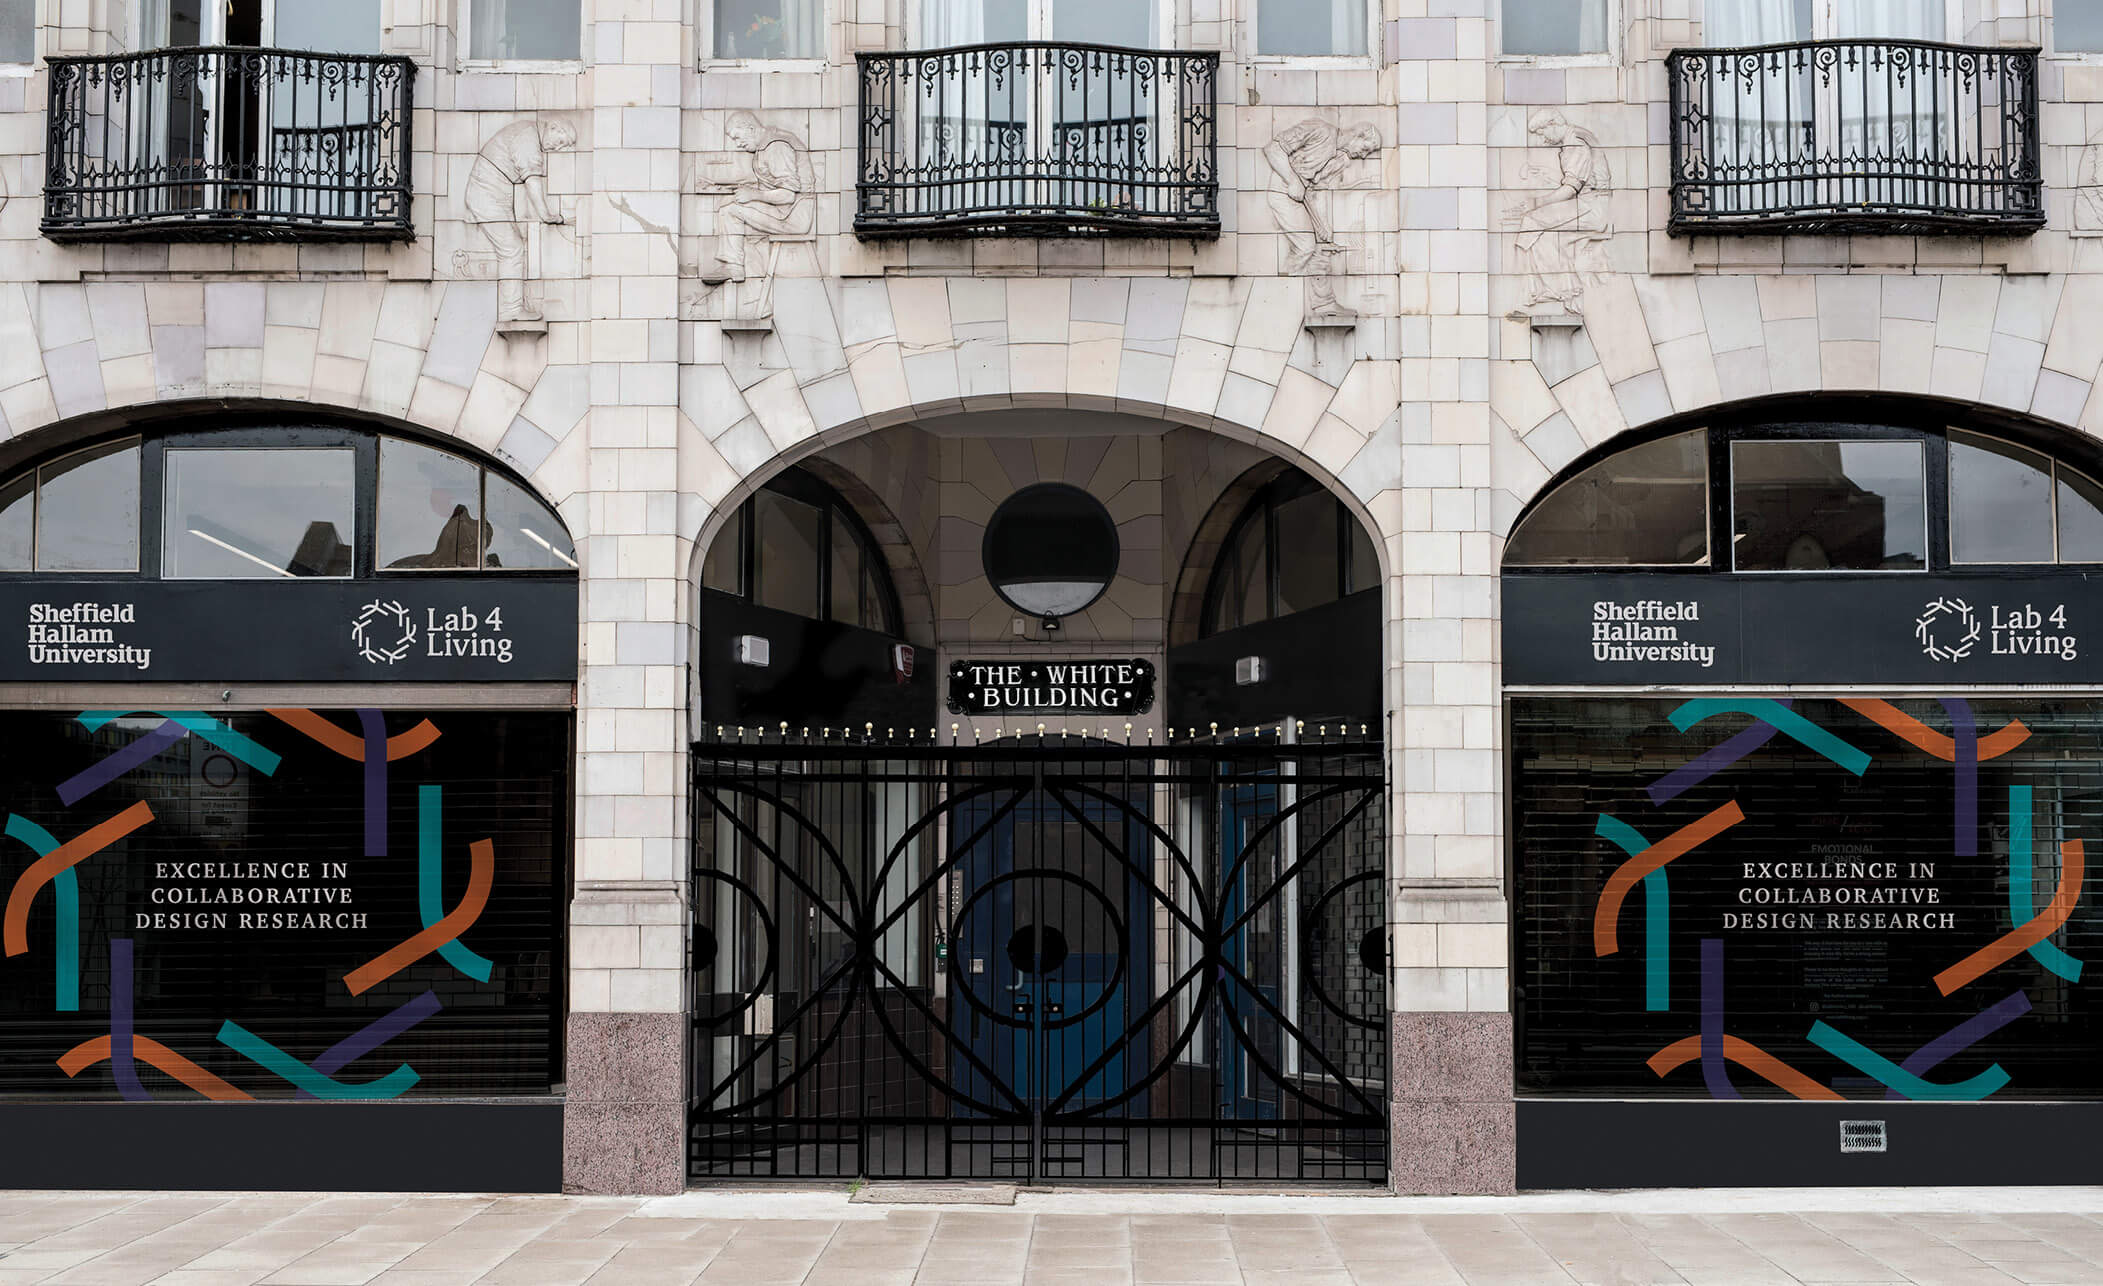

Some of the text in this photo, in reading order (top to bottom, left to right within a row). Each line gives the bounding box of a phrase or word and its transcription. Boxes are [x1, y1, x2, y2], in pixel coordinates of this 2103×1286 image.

[29, 602, 135, 624] Sheffield
[427, 605, 504, 632] Lab 4
[1593, 600, 1699, 621] Sheffield
[1991, 603, 2068, 630] Lab 4
[28, 624, 114, 643] Hallam
[1592, 621, 1678, 641] Hallam
[427, 632, 513, 663] Living
[1592, 641, 1715, 668] University
[1991, 630, 2077, 661] Living
[28, 643, 151, 670] University
[969, 664, 1134, 685] THE WHITE
[983, 687, 1118, 707] BUILDING
[156, 862, 347, 879] EXCELLENCE IN
[1743, 862, 1935, 879] EXCELLENCE IN
[151, 887, 352, 904] COLLABORATIVE
[1738, 887, 1940, 904] COLLABORATIVE
[135, 912, 368, 929] DESIGN RESEARCH
[1723, 913, 1955, 929] DESIGN RESEARCH
